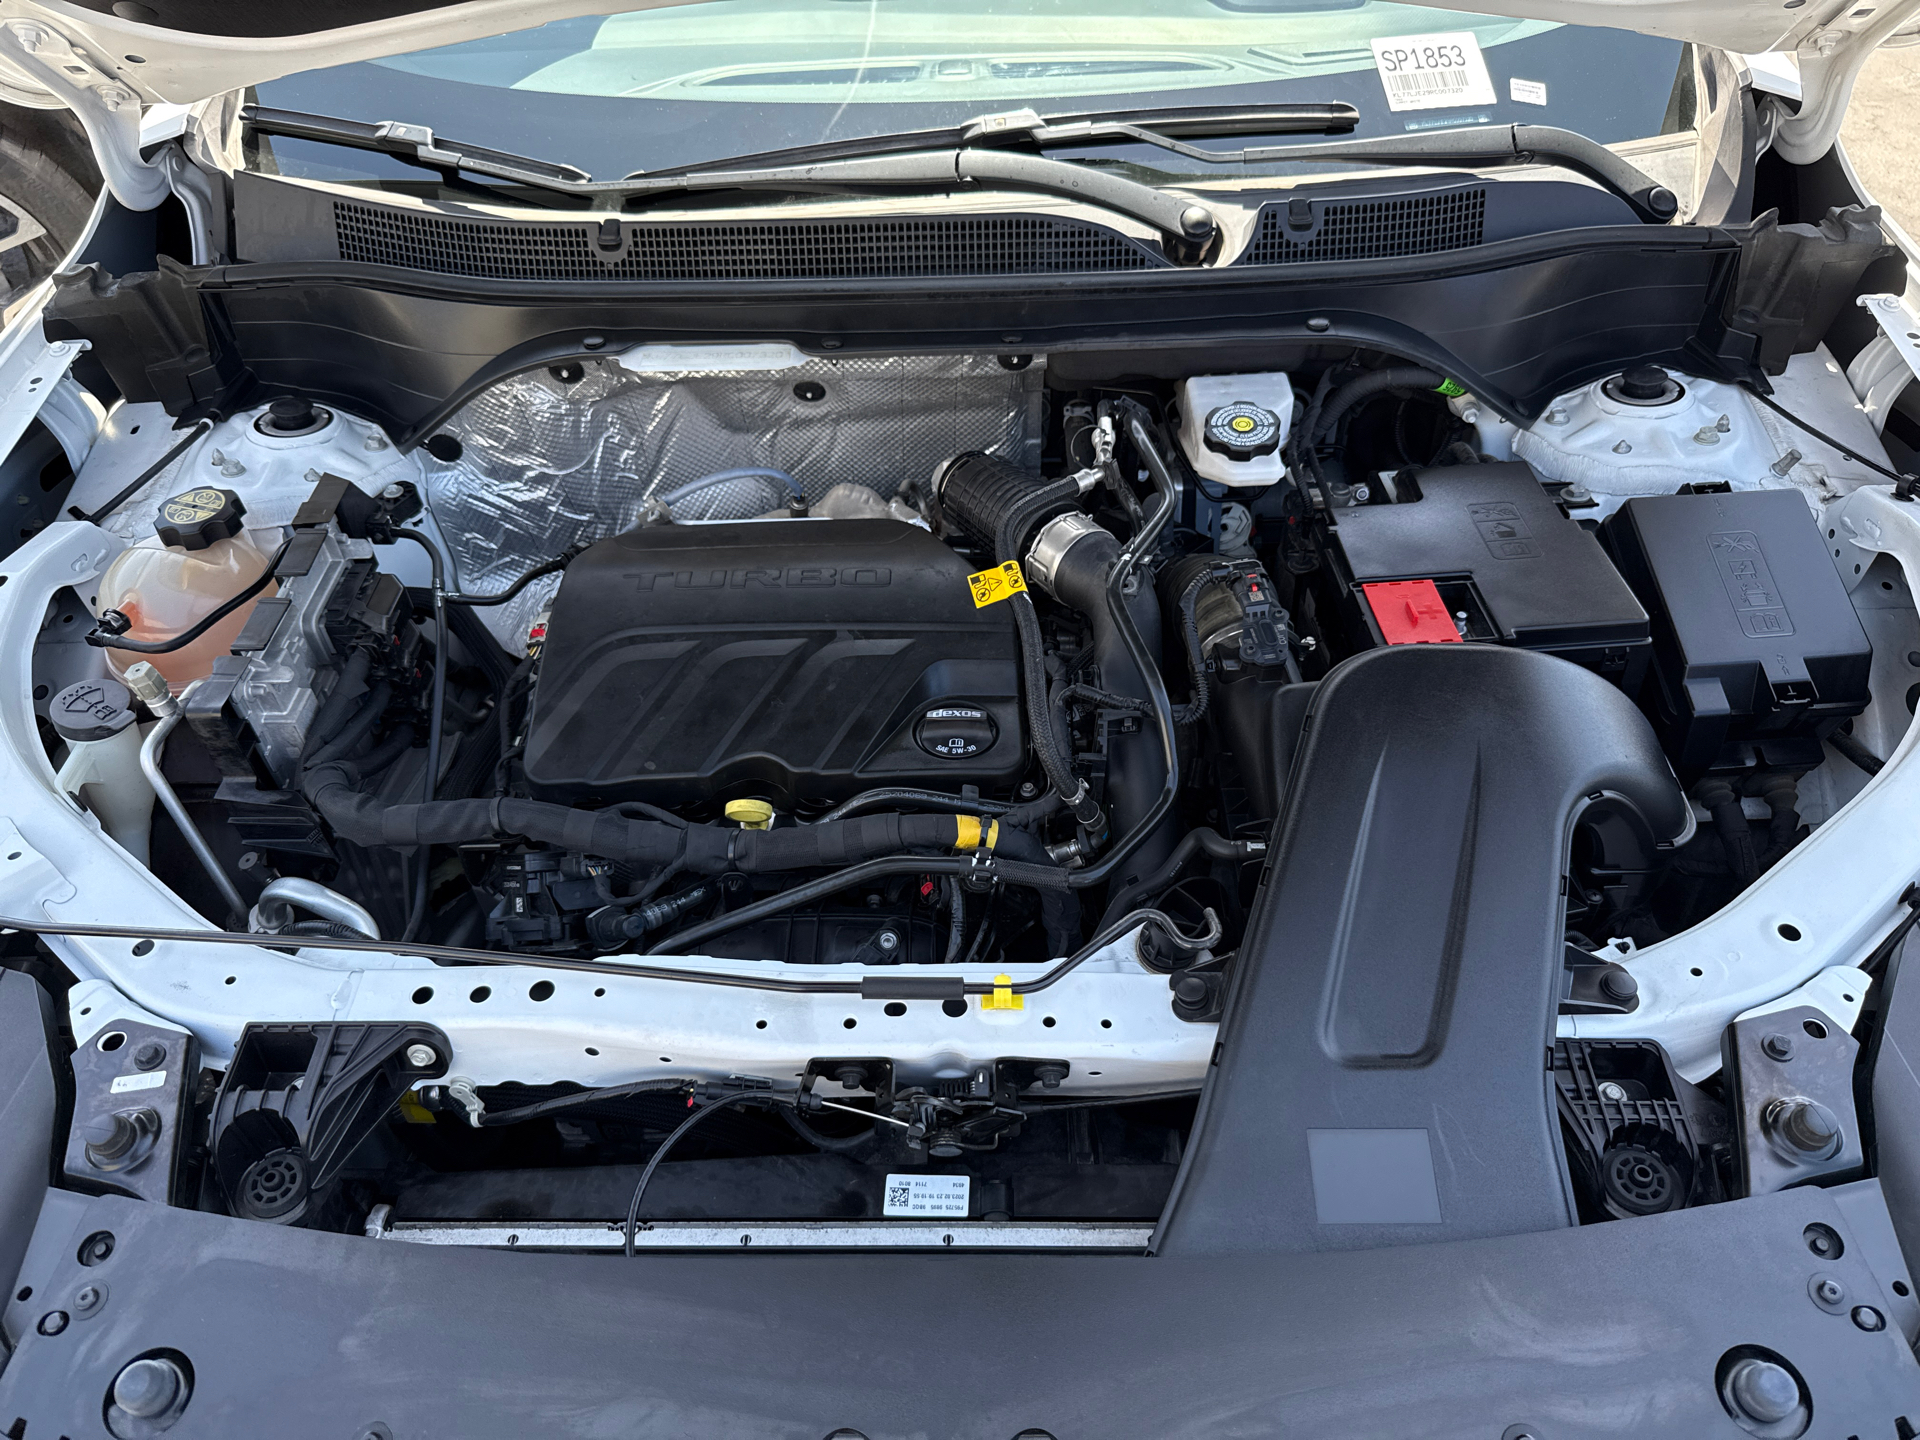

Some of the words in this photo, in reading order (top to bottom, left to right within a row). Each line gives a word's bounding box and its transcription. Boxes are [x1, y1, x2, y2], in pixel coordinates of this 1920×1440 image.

[1381, 45, 1466, 72] SP1853
[622, 568, 892, 592] TURBO
[932, 708, 982, 718] dexos
[936, 744, 950, 754] SAE
[952, 744, 977, 754] 5W-30
